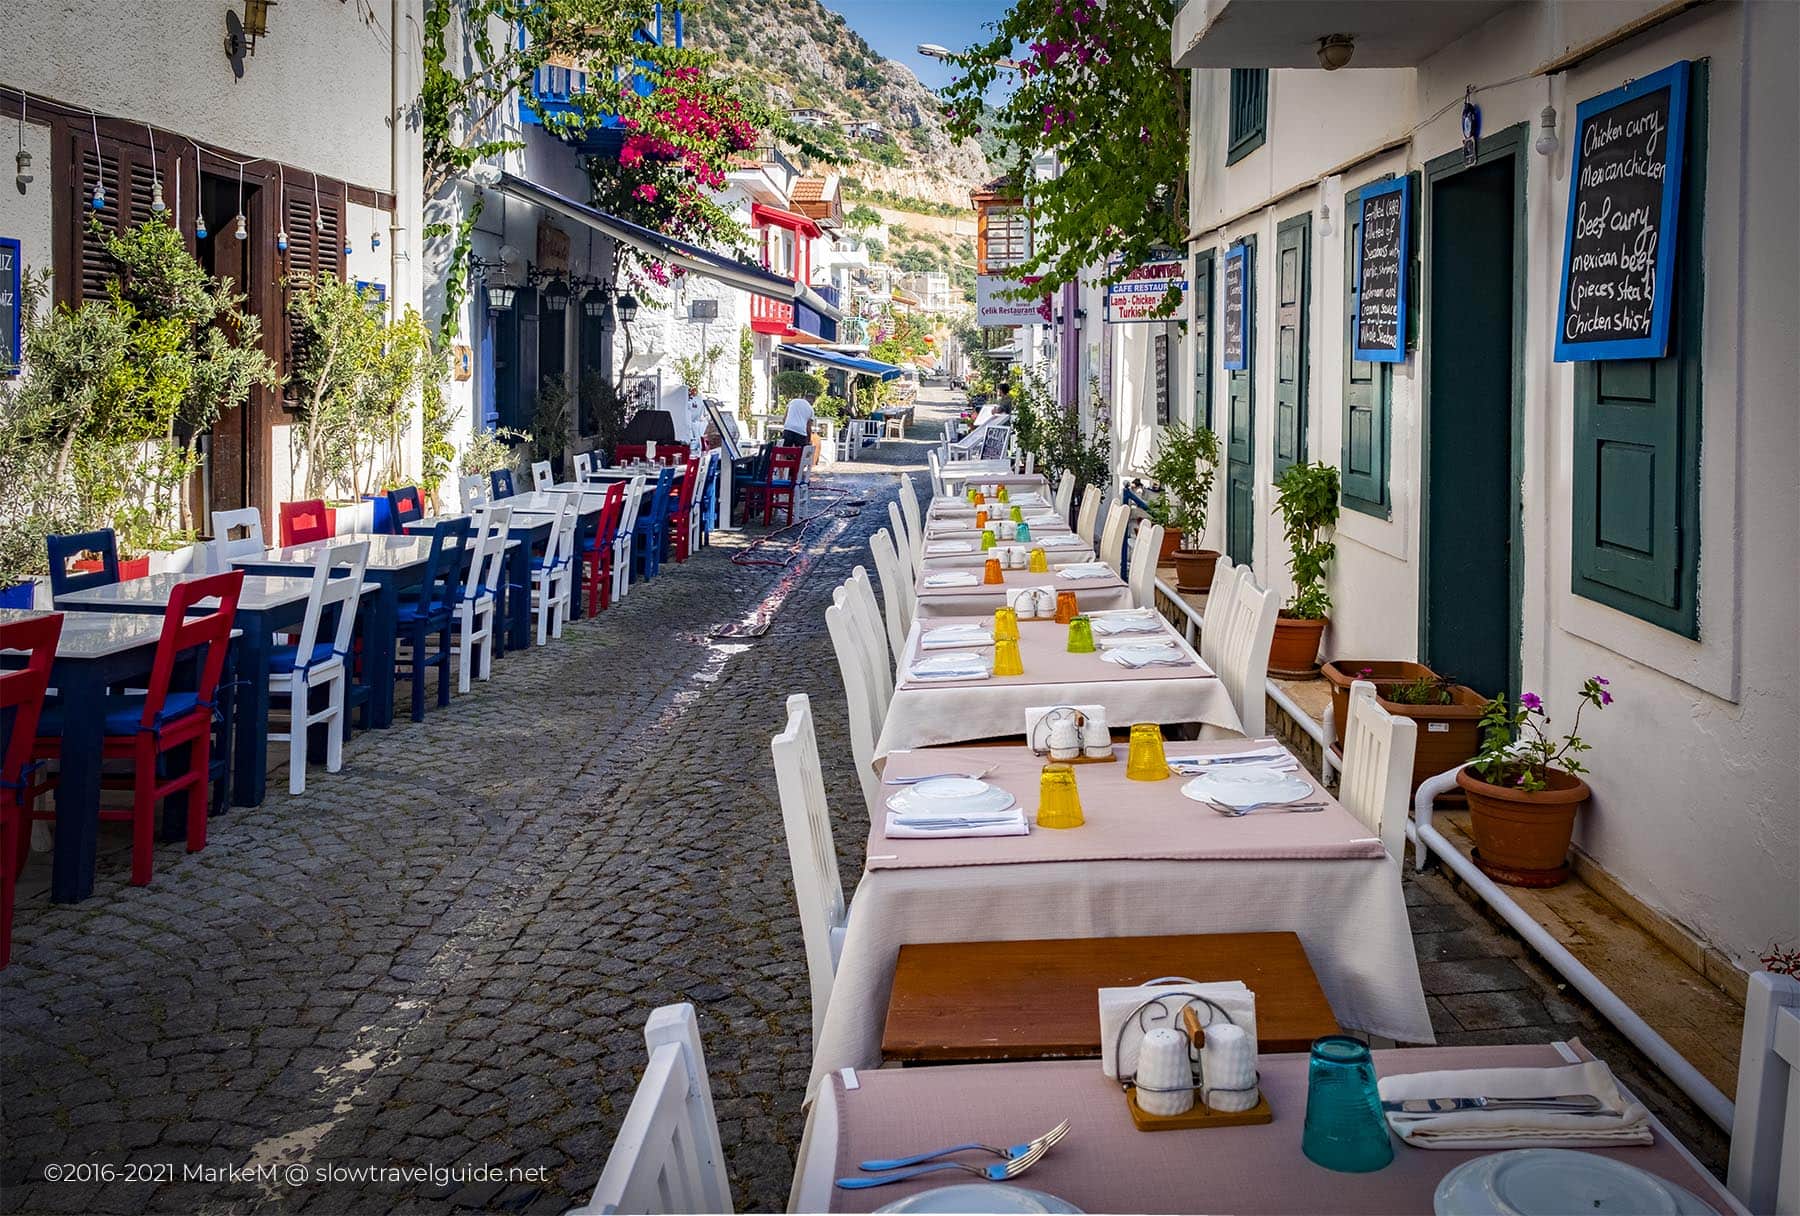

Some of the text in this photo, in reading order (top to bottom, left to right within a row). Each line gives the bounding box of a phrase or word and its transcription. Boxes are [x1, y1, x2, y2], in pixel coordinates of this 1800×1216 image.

[1584, 110, 1664, 157] Chicken curry
[1576, 196, 1654, 257] Beef curry
[1620, 231, 1657, 275] beef
[1110, 296, 1127, 306] Lamb
[1131, 294, 1156, 305] Chicken
[1113, 284, 1133, 293] CAFE
[998, 305, 1036, 314] Restaurant
